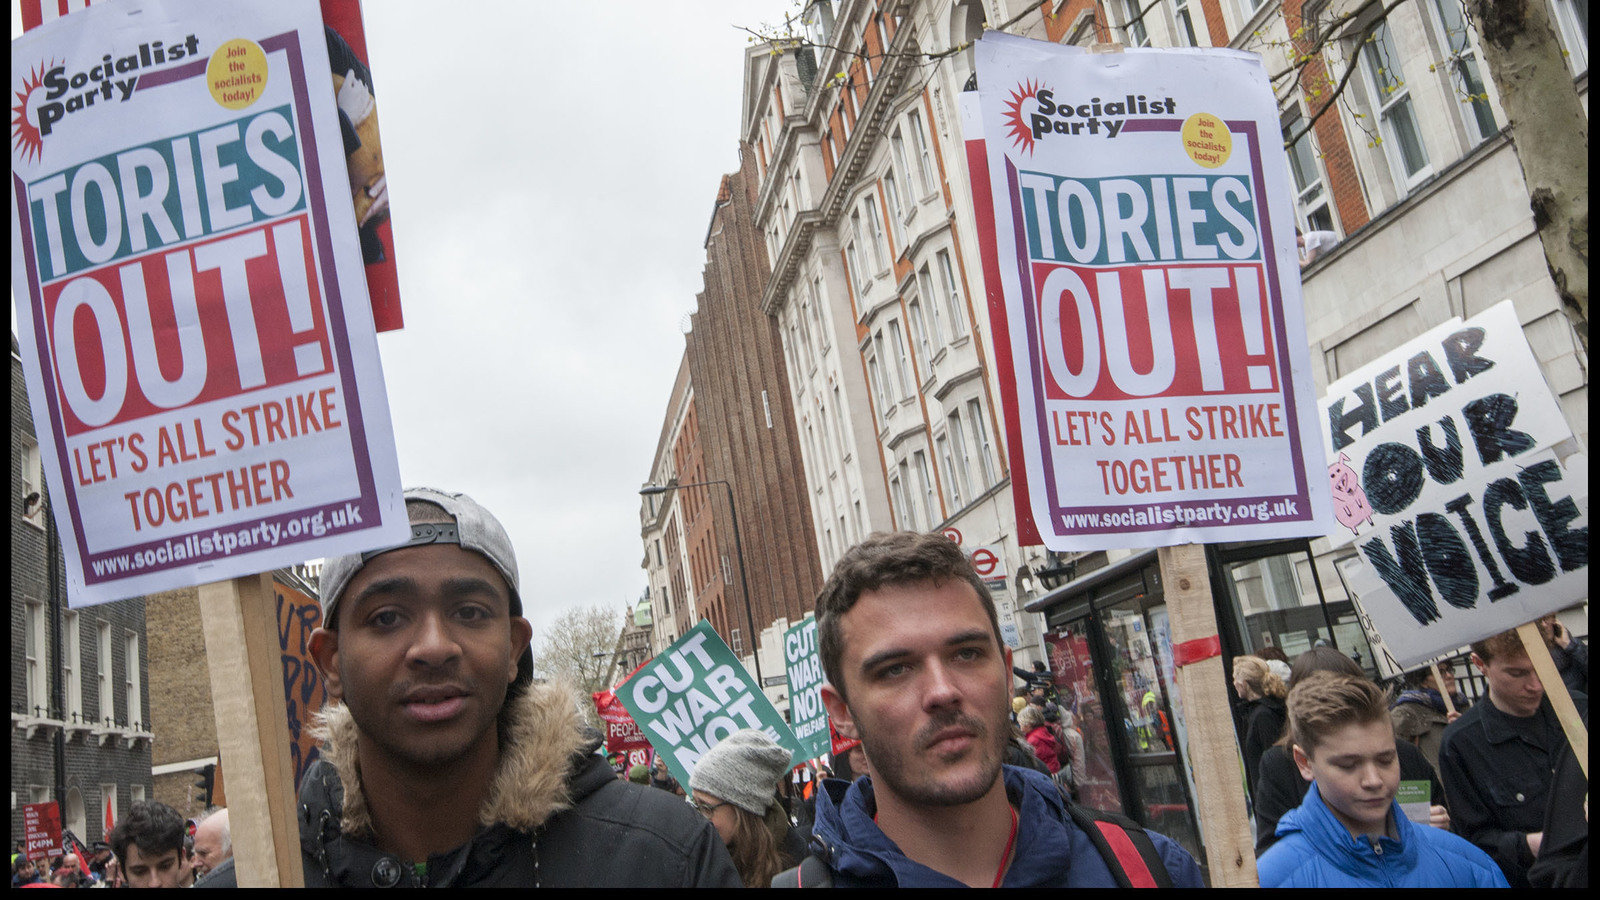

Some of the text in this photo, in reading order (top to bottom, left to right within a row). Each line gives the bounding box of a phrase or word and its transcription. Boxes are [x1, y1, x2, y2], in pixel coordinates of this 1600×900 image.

[42, 33, 200, 101] Socialist
[226, 46, 247, 59] Join
[228, 60, 246, 72] the
[214, 71, 262, 91] socialists
[222, 88, 255, 103] today!
[37, 75, 138, 136] Party
[1036, 89, 1176, 119] Socialist
[1198, 118, 1214, 128] Join
[1030, 113, 1124, 140] Party
[1187, 139, 1227, 153] socialists
[1199, 130, 1213, 139] the
[1194, 150, 1220, 164] today!
[29, 110, 302, 277] TORIES
[1021, 172, 1259, 264] TORIES
[53, 218, 325, 427] OUT!
[1040, 266, 1274, 398] OUT!
[1327, 326, 1497, 453] HEAR
[73, 386, 342, 487] LET'S ALL STRIKE
[1052, 403, 1285, 447] LET'S ALL STRIKE
[1096, 453, 1245, 496] TOGETHER
[1362, 392, 1537, 515] OUR
[124, 458, 295, 532] TOGETHER
[1061, 498, 1299, 529] www.socialistparty.org.uk
[91, 502, 363, 577] www.socialistparty.org.uk
[1360, 459, 1588, 627] VOICE
[786, 621, 816, 663] CUT
[632, 631, 716, 714] CUT
[788, 653, 822, 692] WAR
[648, 664, 748, 747] WAR
[793, 682, 823, 724] NOT
[795, 715, 825, 739] WELFARE
[630, 749, 646, 767] GO
